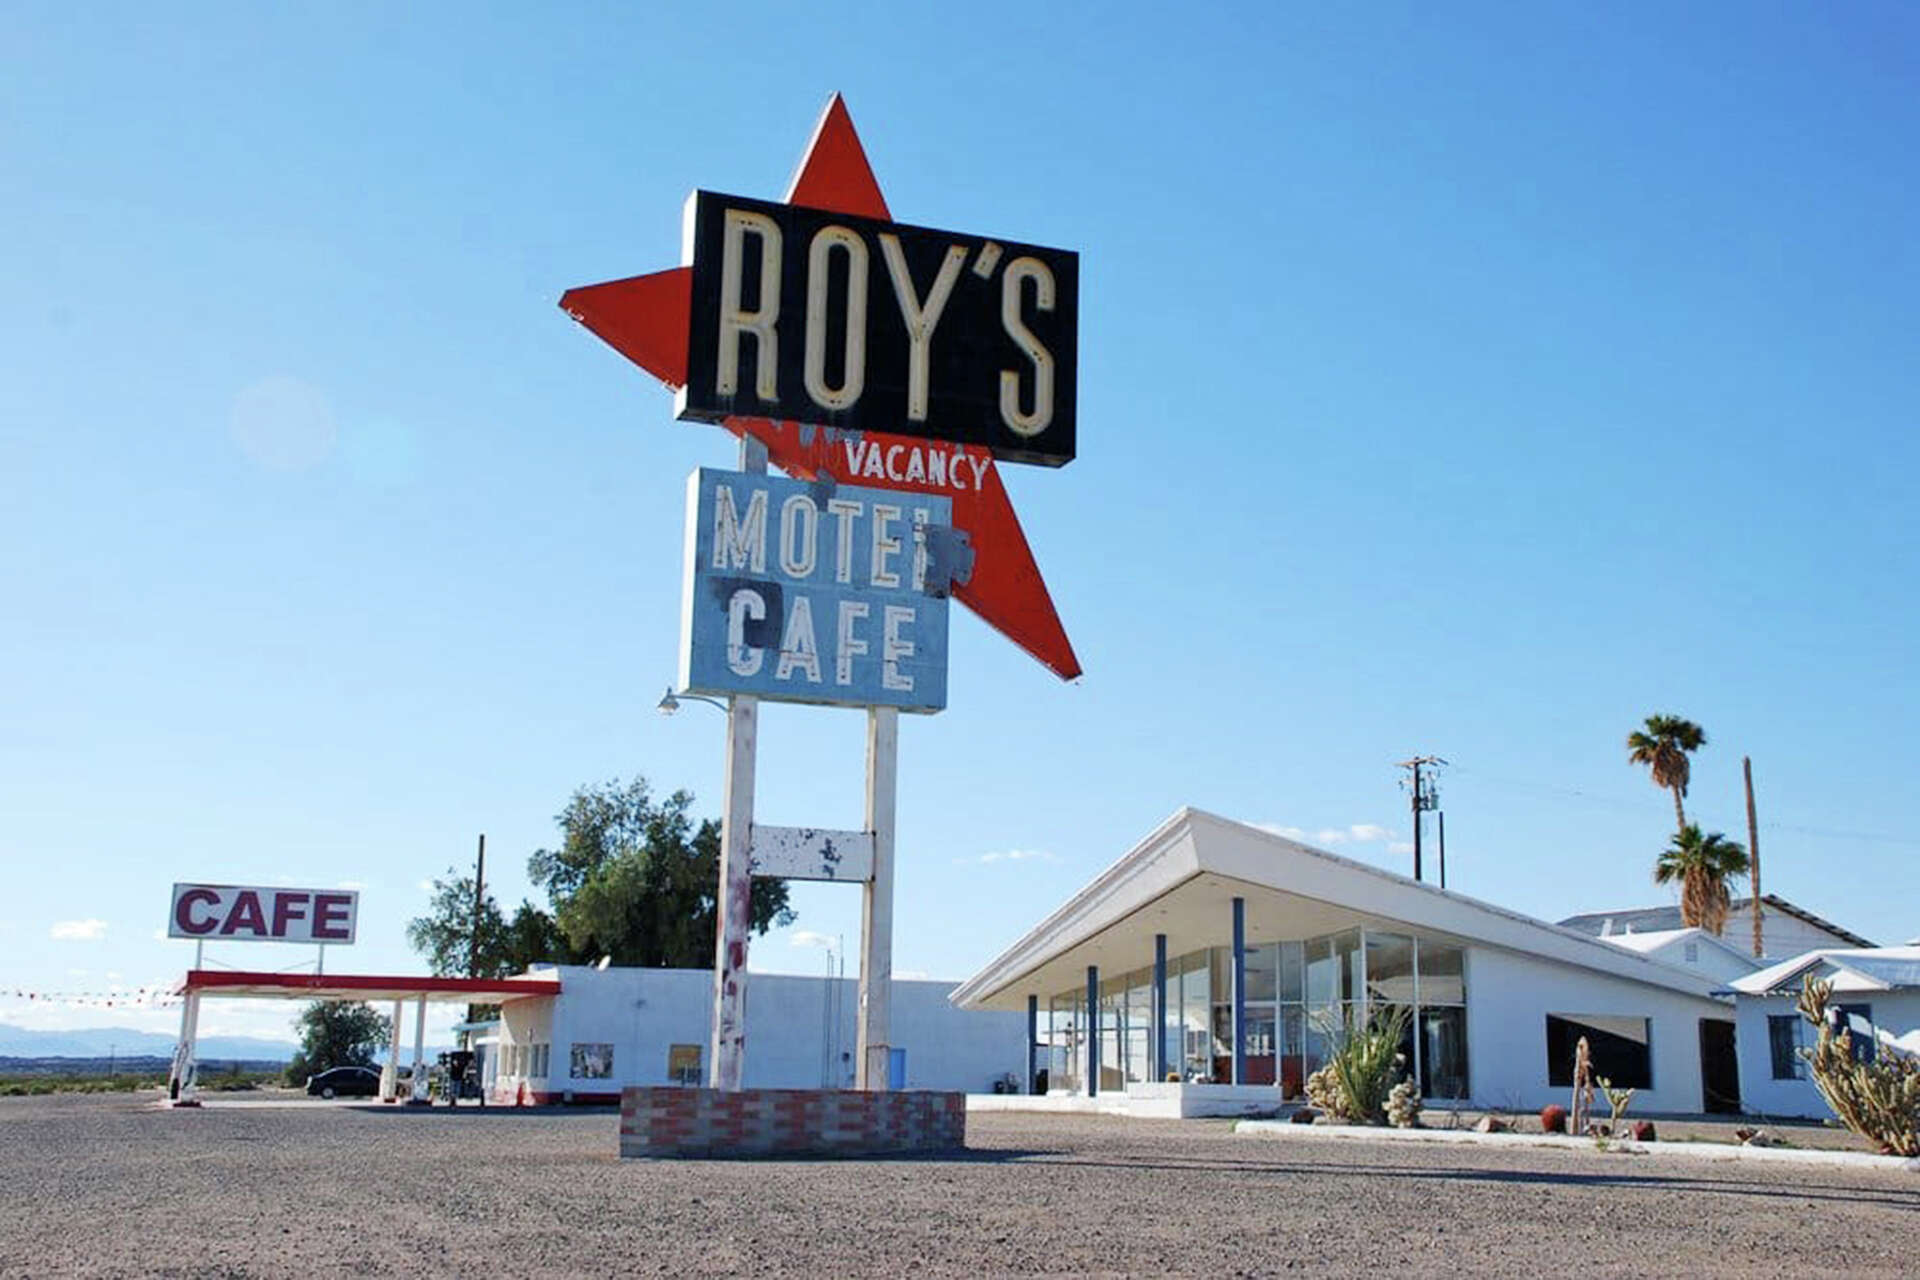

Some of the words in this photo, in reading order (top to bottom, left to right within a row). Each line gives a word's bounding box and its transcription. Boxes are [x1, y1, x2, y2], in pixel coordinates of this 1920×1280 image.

[716, 208, 1056, 436] ROY'S
[844, 438, 991, 490] VACANCY
[728, 589, 915, 691] CAFE
[175, 888, 352, 939] CAFE
